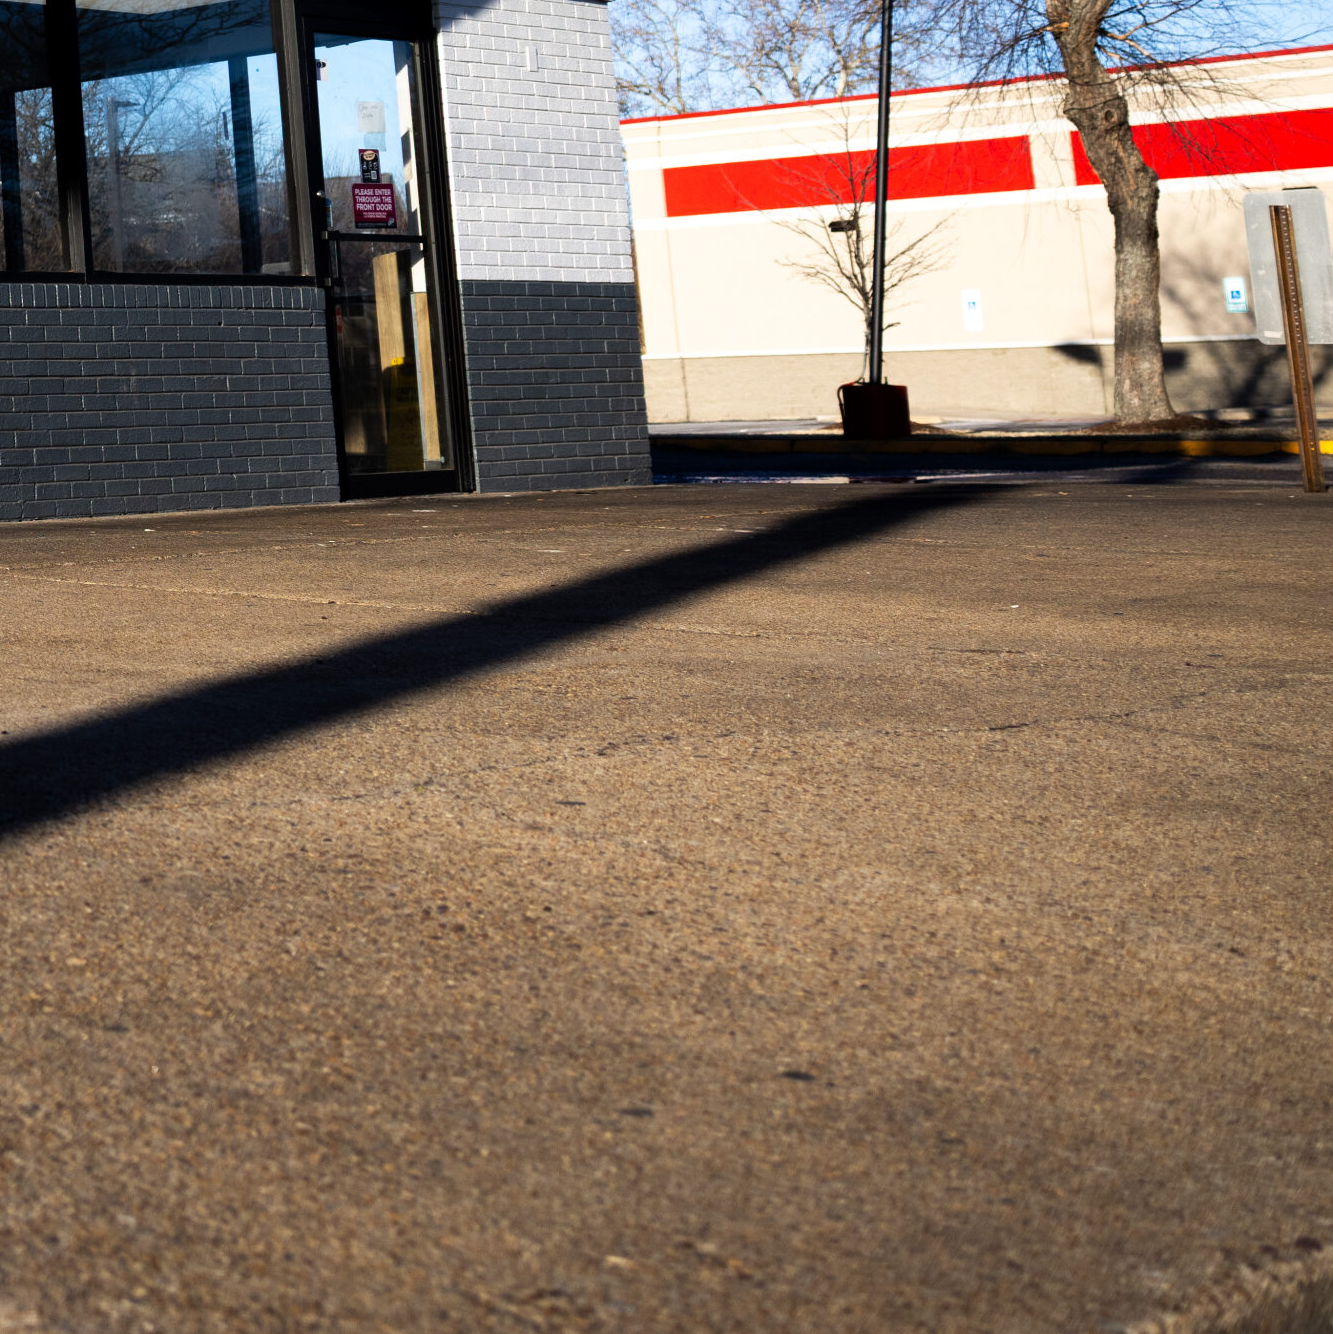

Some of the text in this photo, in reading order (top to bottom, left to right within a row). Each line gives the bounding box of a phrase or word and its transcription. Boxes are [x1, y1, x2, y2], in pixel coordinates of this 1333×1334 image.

[354, 188, 392, 196] PLEASE ENTER
[356, 203, 393, 211] FRONT DOOR
